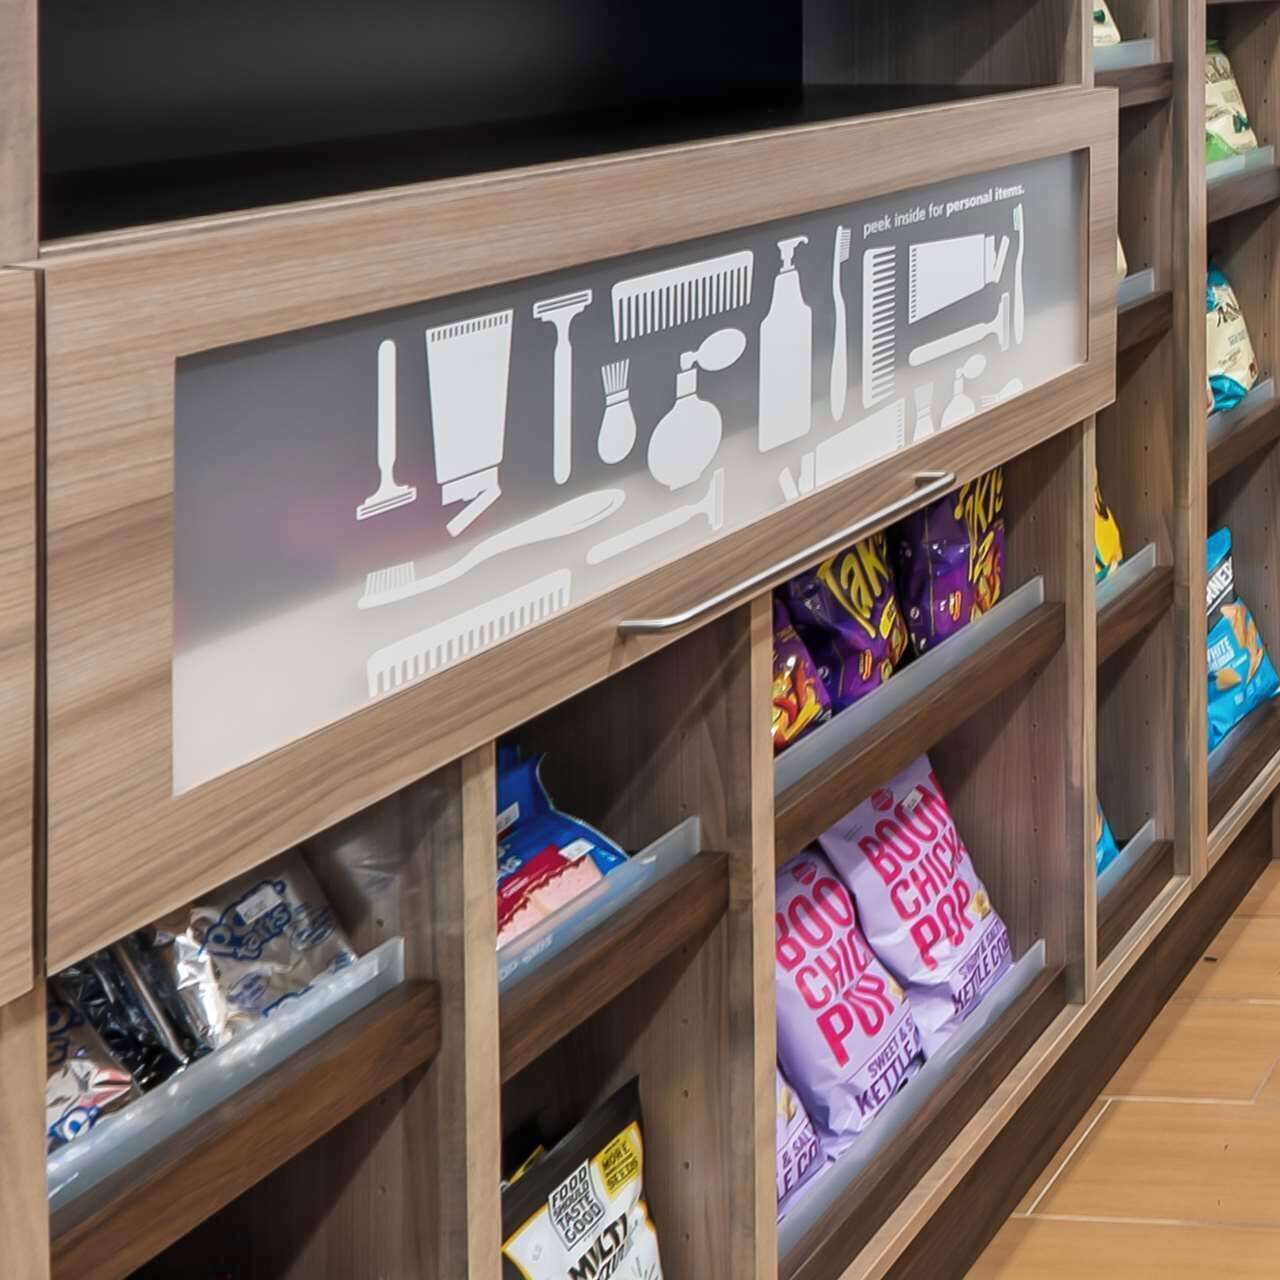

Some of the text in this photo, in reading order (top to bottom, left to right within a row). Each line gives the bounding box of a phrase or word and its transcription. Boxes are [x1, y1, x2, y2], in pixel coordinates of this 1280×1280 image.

[863, 184, 1025, 239] peek inside for personal items.
[910, 879, 976, 972] POP
[551, 1164, 589, 1210] FOOD
[552, 1181, 590, 1219] SHOULD
[554, 1189, 595, 1232] TASTE
[564, 1200, 603, 1246] GOOD
